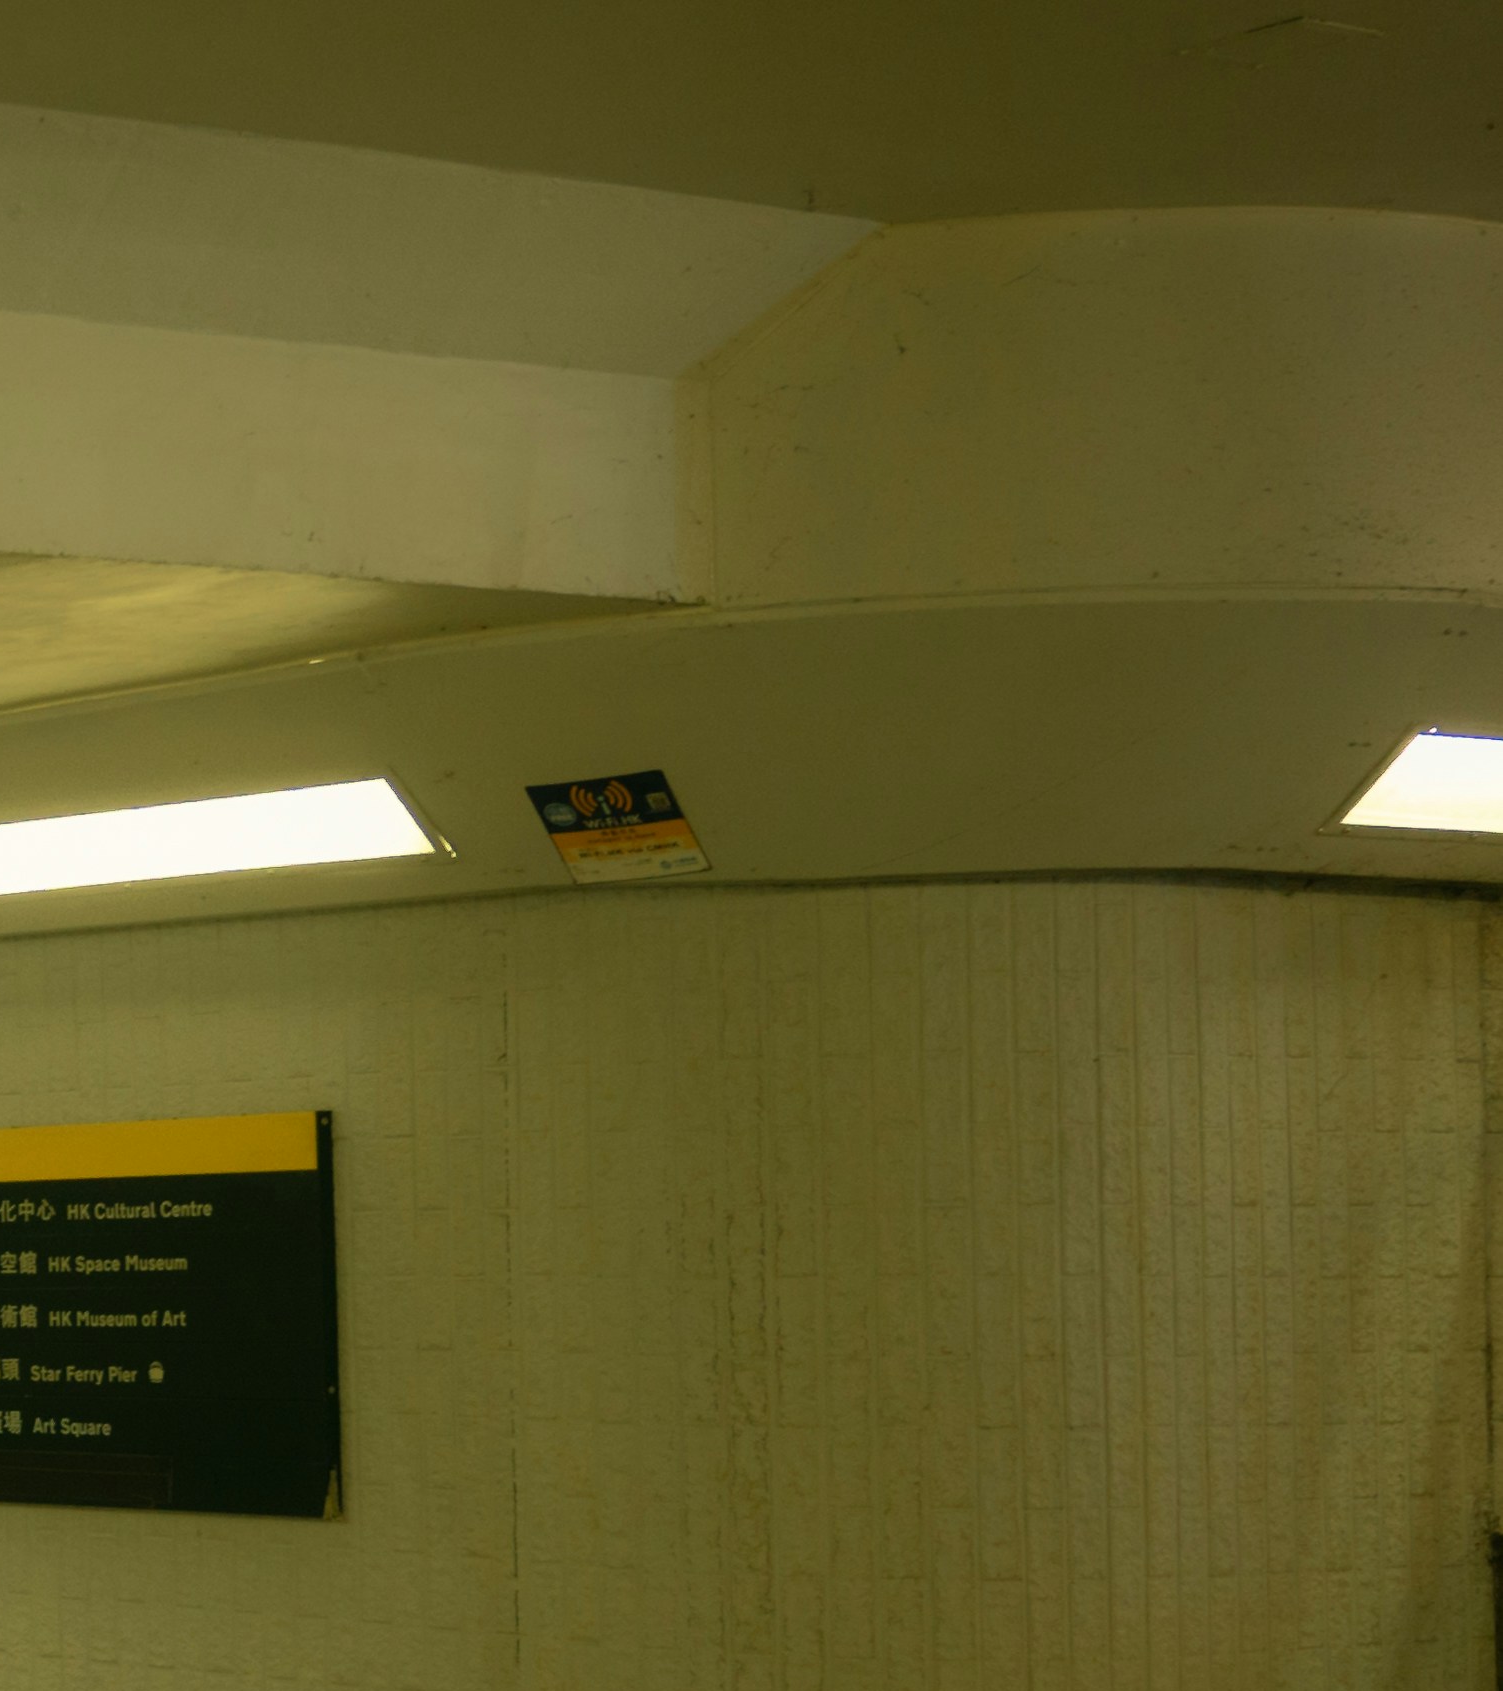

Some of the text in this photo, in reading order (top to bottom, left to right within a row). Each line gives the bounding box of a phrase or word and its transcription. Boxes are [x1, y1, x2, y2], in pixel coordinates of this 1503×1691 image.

[67, 1203, 91, 1220] HK
[94, 1201, 157, 1220] Cultural
[159, 1200, 213, 1218] Centre
[48, 1256, 71, 1273] HK
[75, 1255, 121, 1275] Space
[125, 1254, 188, 1272] Museum
[49, 1310, 72, 1327] HK
[76, 1310, 138, 1328] Museum
[141, 1310, 158, 1327] of
[162, 1310, 187, 1327] Art
[30, 1364, 62, 1382] Star
[66, 1365, 104, 1386] Ferry
[108, 1365, 138, 1383] Pier
[32, 1417, 56, 1435] Art
[60, 1417, 112, 1438] Square
